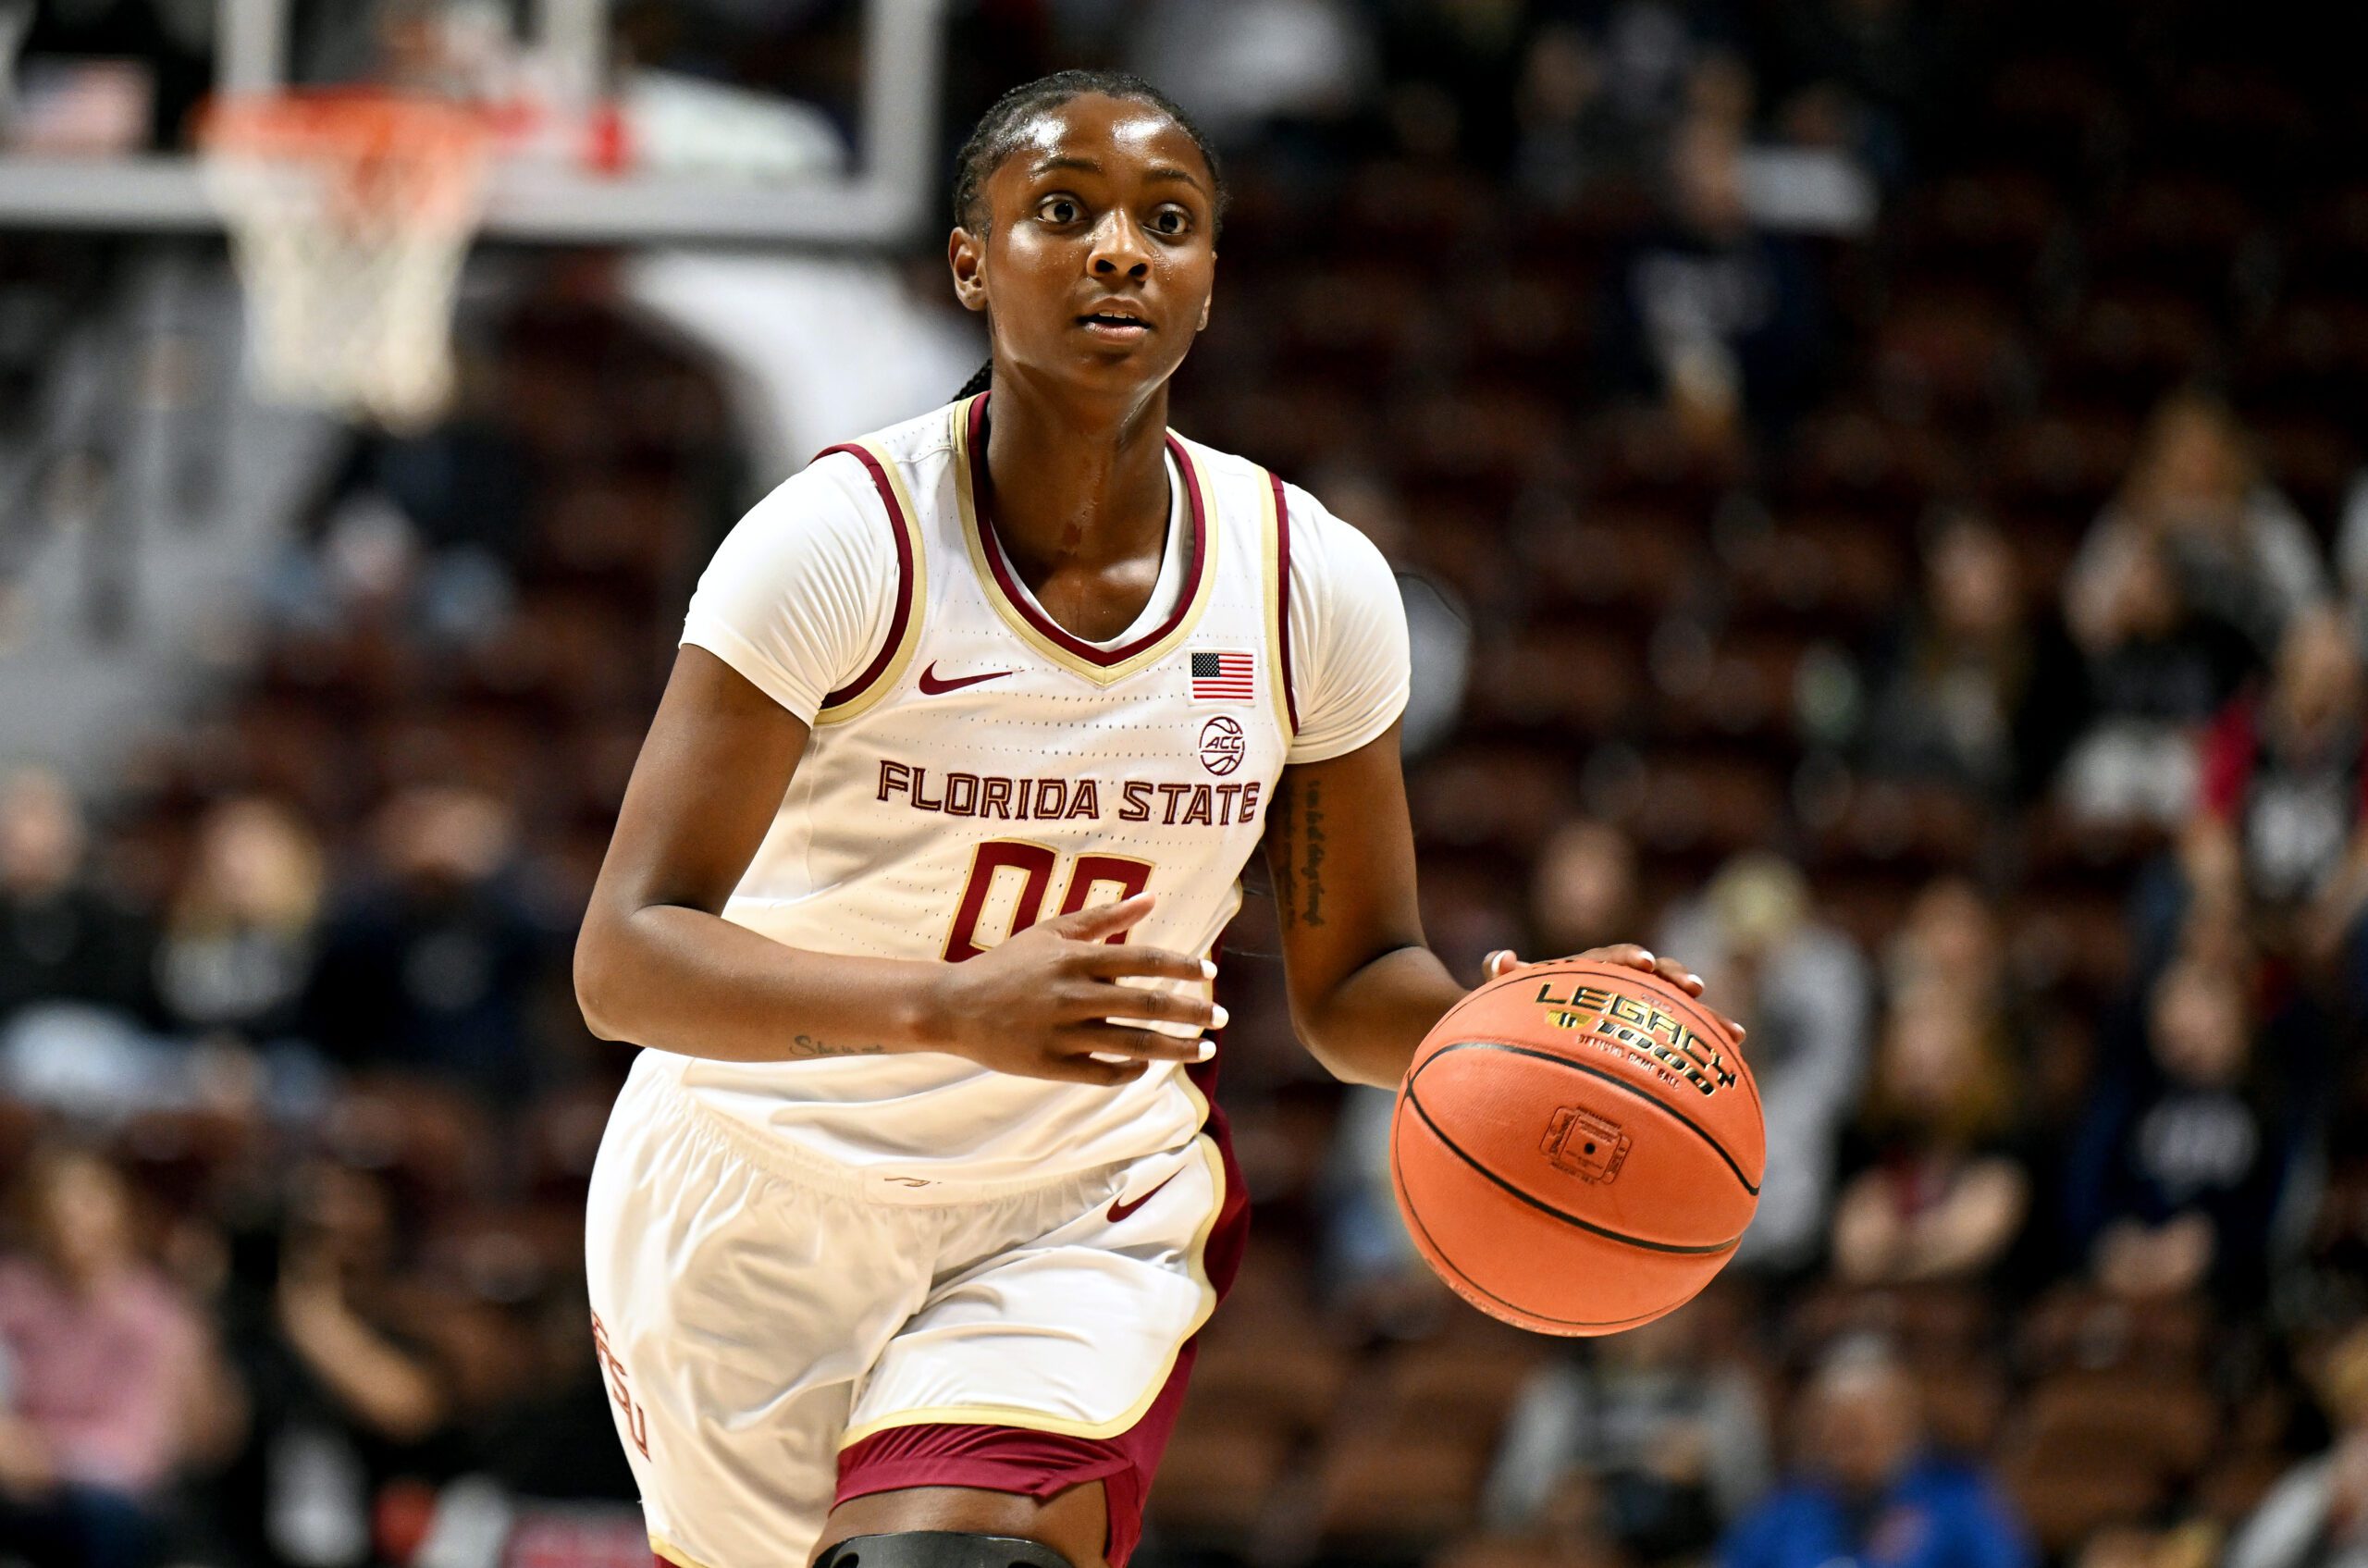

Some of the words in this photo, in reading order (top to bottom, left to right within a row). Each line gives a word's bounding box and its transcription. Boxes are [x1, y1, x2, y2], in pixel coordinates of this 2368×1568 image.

[1205, 736, 1243, 749] ACC
[877, 759, 1099, 821] FLORIDA
[1119, 781, 1261, 826] STATE
[1536, 982, 1737, 1090] LEGACY
[1628, 1052, 1657, 1072] GAME
[1657, 1068, 1680, 1090] BALL
